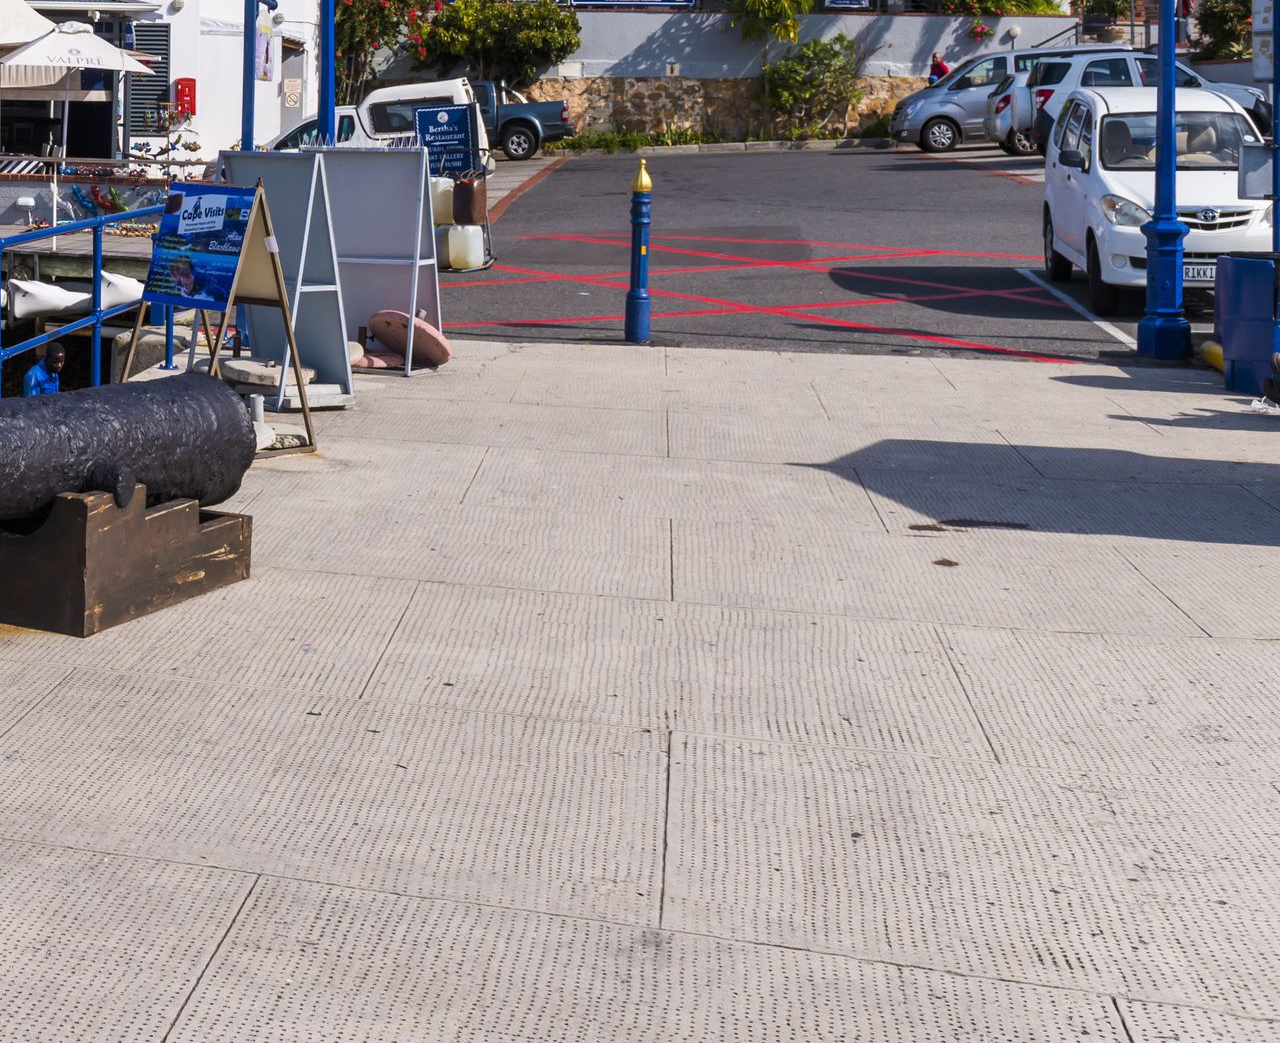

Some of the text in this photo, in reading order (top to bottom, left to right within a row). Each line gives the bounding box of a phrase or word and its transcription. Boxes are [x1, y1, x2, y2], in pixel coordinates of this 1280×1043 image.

[429, 124, 458, 133] Bertha's
[425, 133, 465, 142] Restaurant
[182, 206, 225, 222] Cape Visits
